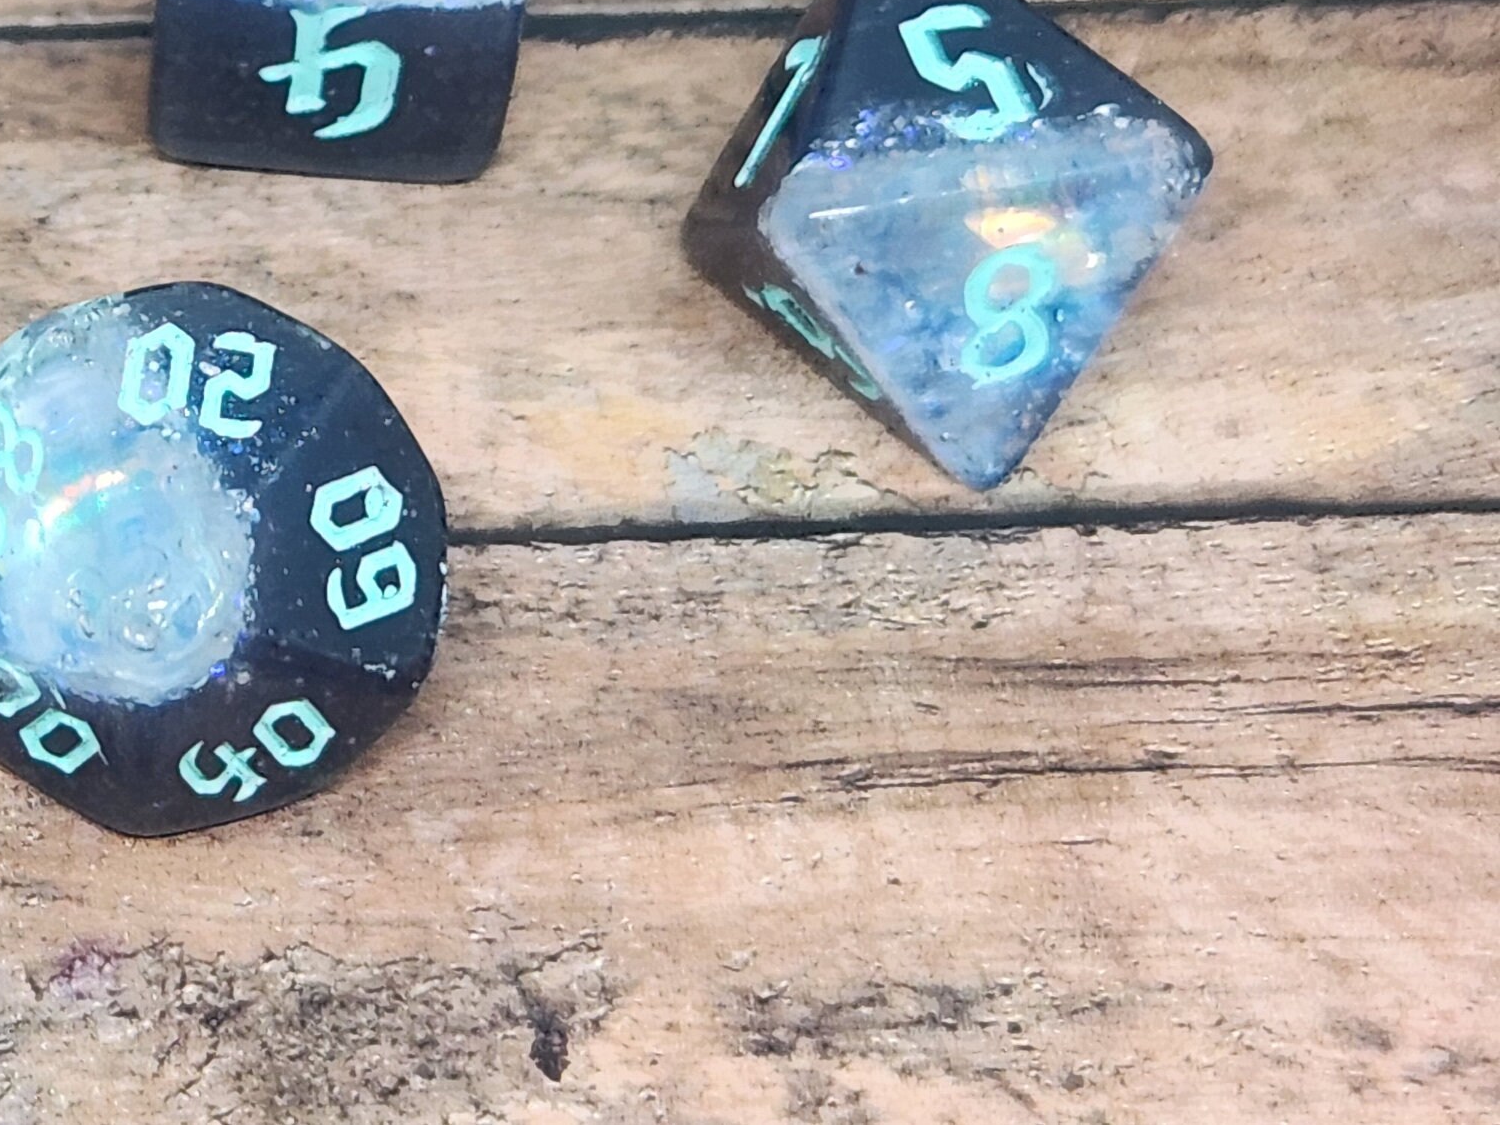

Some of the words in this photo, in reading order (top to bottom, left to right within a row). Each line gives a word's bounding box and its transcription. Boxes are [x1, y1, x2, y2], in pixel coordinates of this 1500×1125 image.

[258, 5, 402, 140] 4
[898, 3, 1040, 141] 5
[961, 242, 1056, 389] 8
